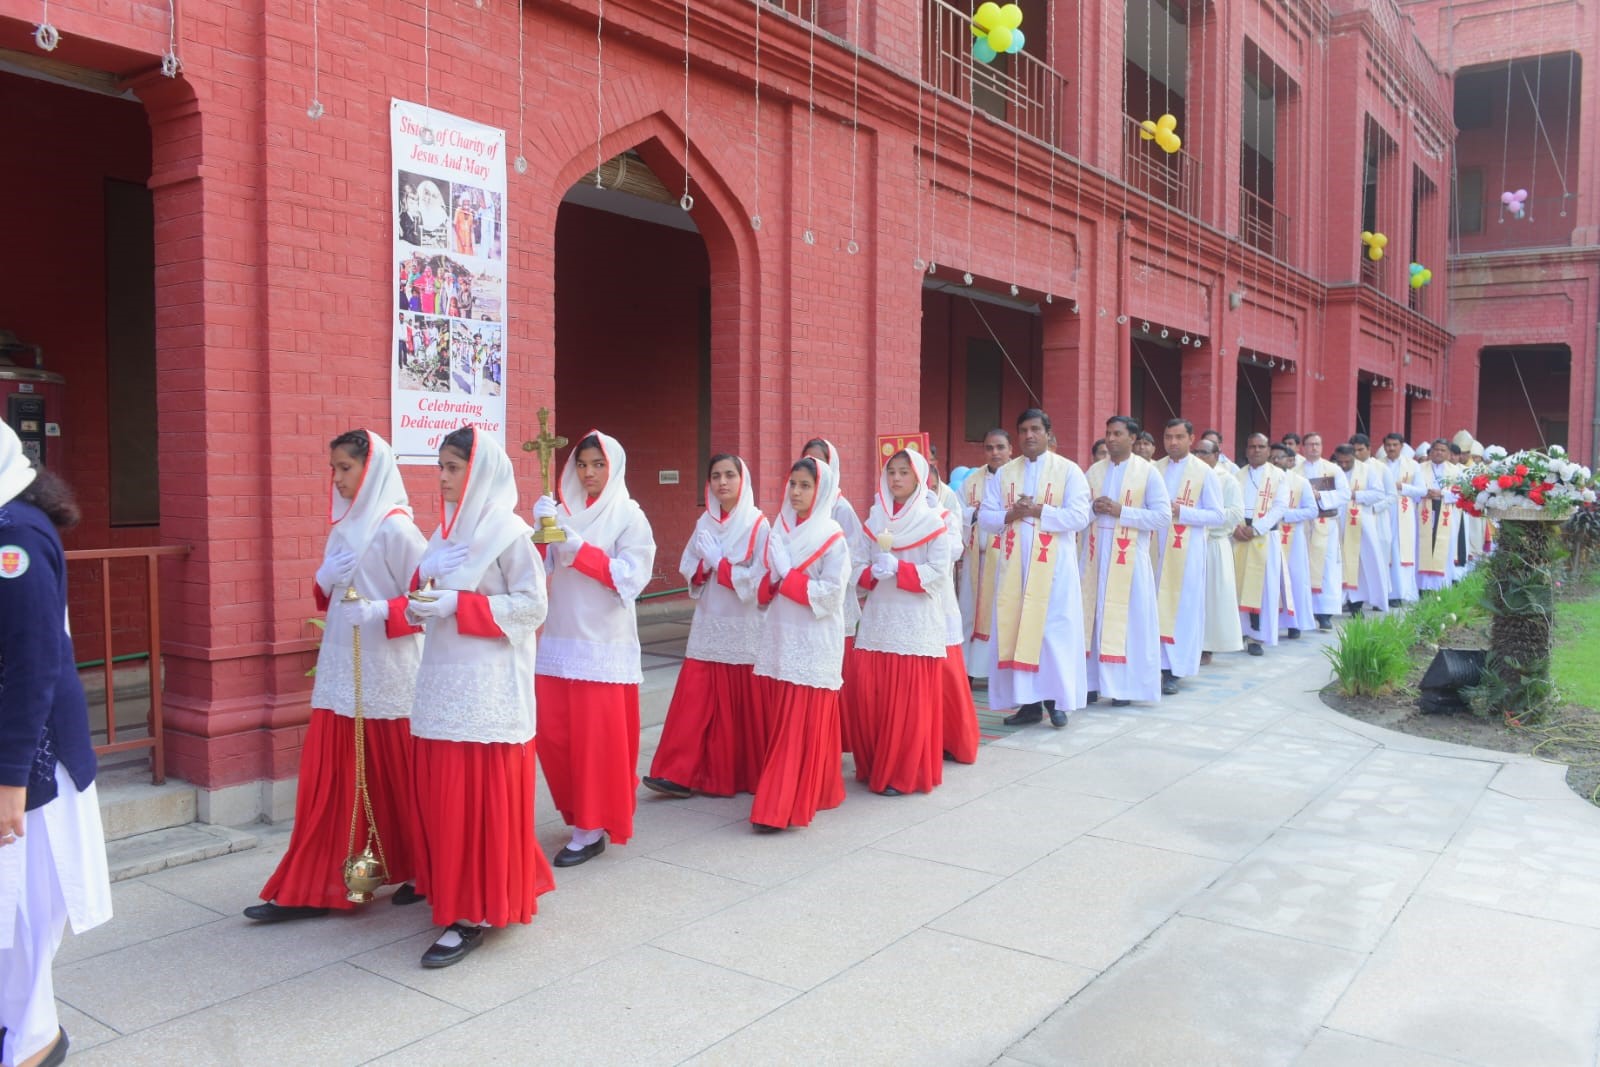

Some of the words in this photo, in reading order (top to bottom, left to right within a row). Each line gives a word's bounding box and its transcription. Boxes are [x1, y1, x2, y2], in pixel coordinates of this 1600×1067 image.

[400, 116, 434, 142] Sist
[436, 128, 448, 146] of
[449, 130, 484, 155] Charity
[487, 142, 498, 160] of
[410, 144, 438, 164] Jesus
[441, 153, 462, 170] And
[465, 157, 490, 180] Mary
[418, 398, 483, 416] Celebrating
[400, 414, 458, 429] Dedicated
[460, 417, 499, 431] Srvice
[427, 434, 440, 449] of
